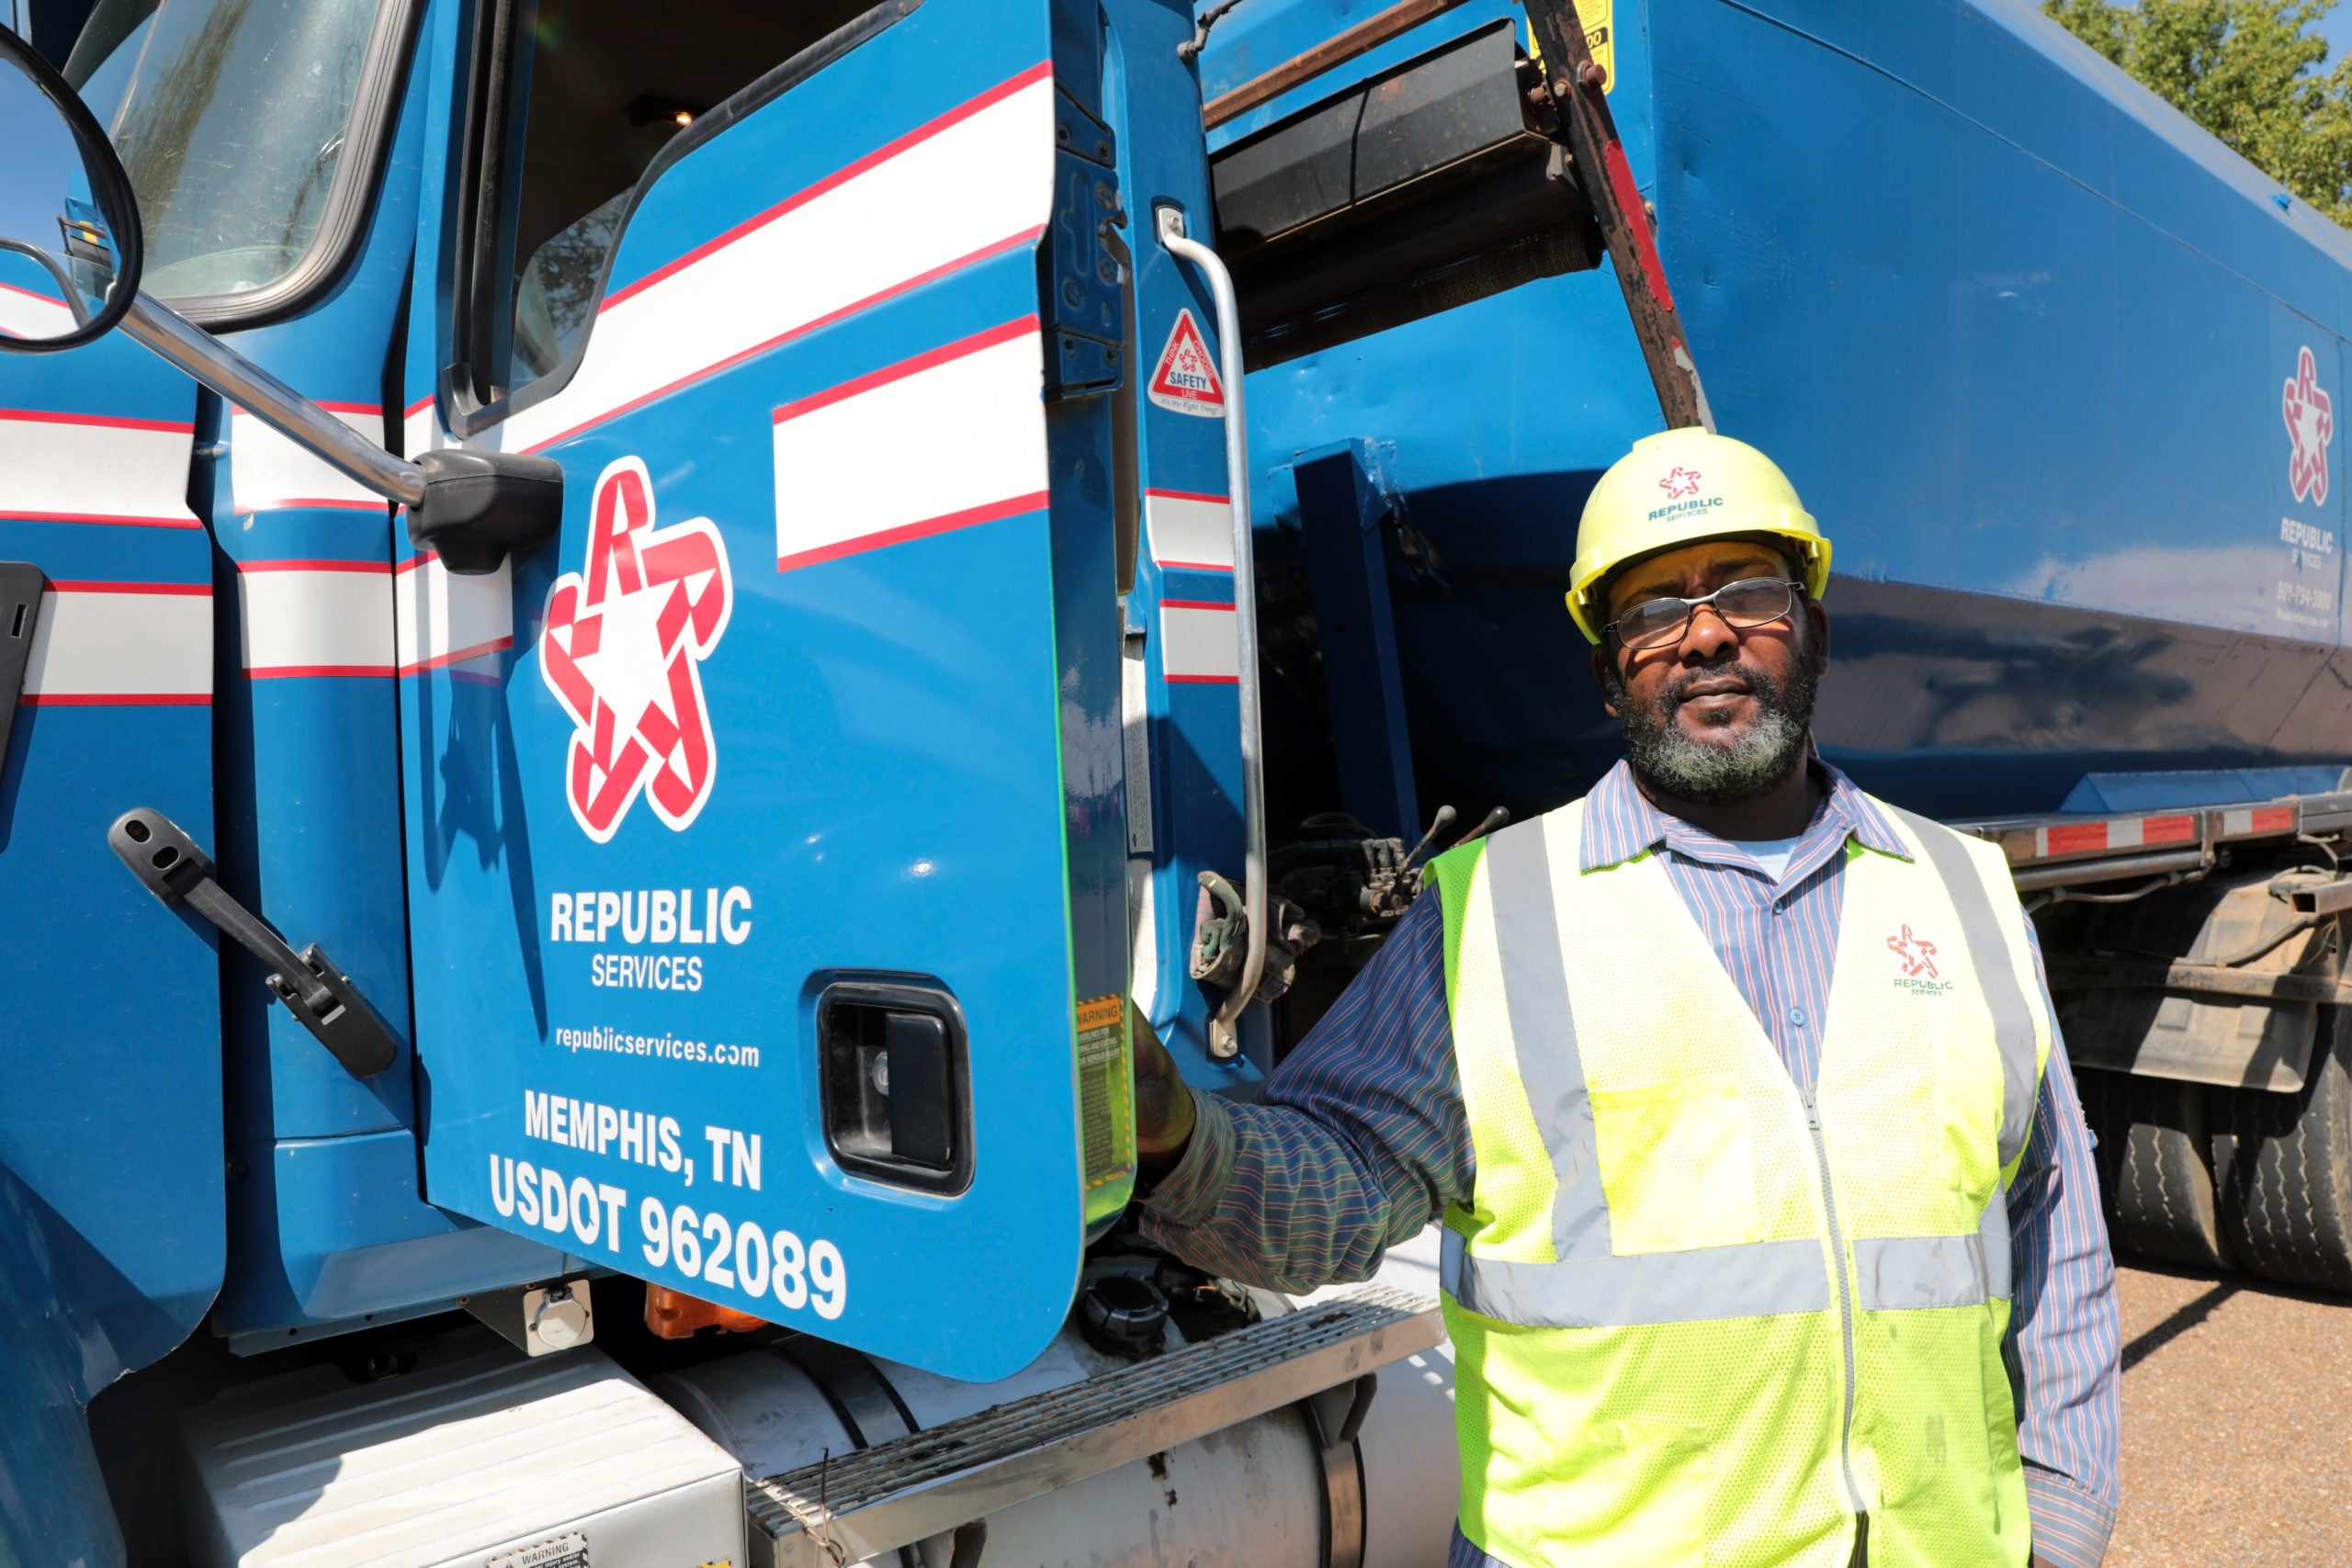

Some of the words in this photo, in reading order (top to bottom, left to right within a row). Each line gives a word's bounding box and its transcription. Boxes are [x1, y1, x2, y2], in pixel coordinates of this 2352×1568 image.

[1164, 340, 1180, 365] THINK
[1193, 340, 1215, 379] CHOOSE
[1170, 371, 1206, 389] SAFETY
[1182, 389, 1198, 400] LIVE
[1182, 401, 1199, 412] Right
[1648, 497, 1724, 521] REPUBLIC
[1666, 508, 1708, 523] SERVICES
[2280, 517, 2333, 554] REPUBLIC
[2291, 548, 2322, 570] SRVICES
[550, 885, 753, 946] REPUBLIC
[591, 953, 704, 992] SERVICES
[1894, 979, 1953, 989] REPUBLIC
[556, 1026, 760, 1067] republicservices.com
[525, 1089, 695, 1187] MEMPHIS,
[705, 1125, 762, 1191] TN
[490, 1153, 628, 1253] USDOT
[639, 1196, 847, 1320] 962089
[522, 1543, 569, 1564] WARNING
